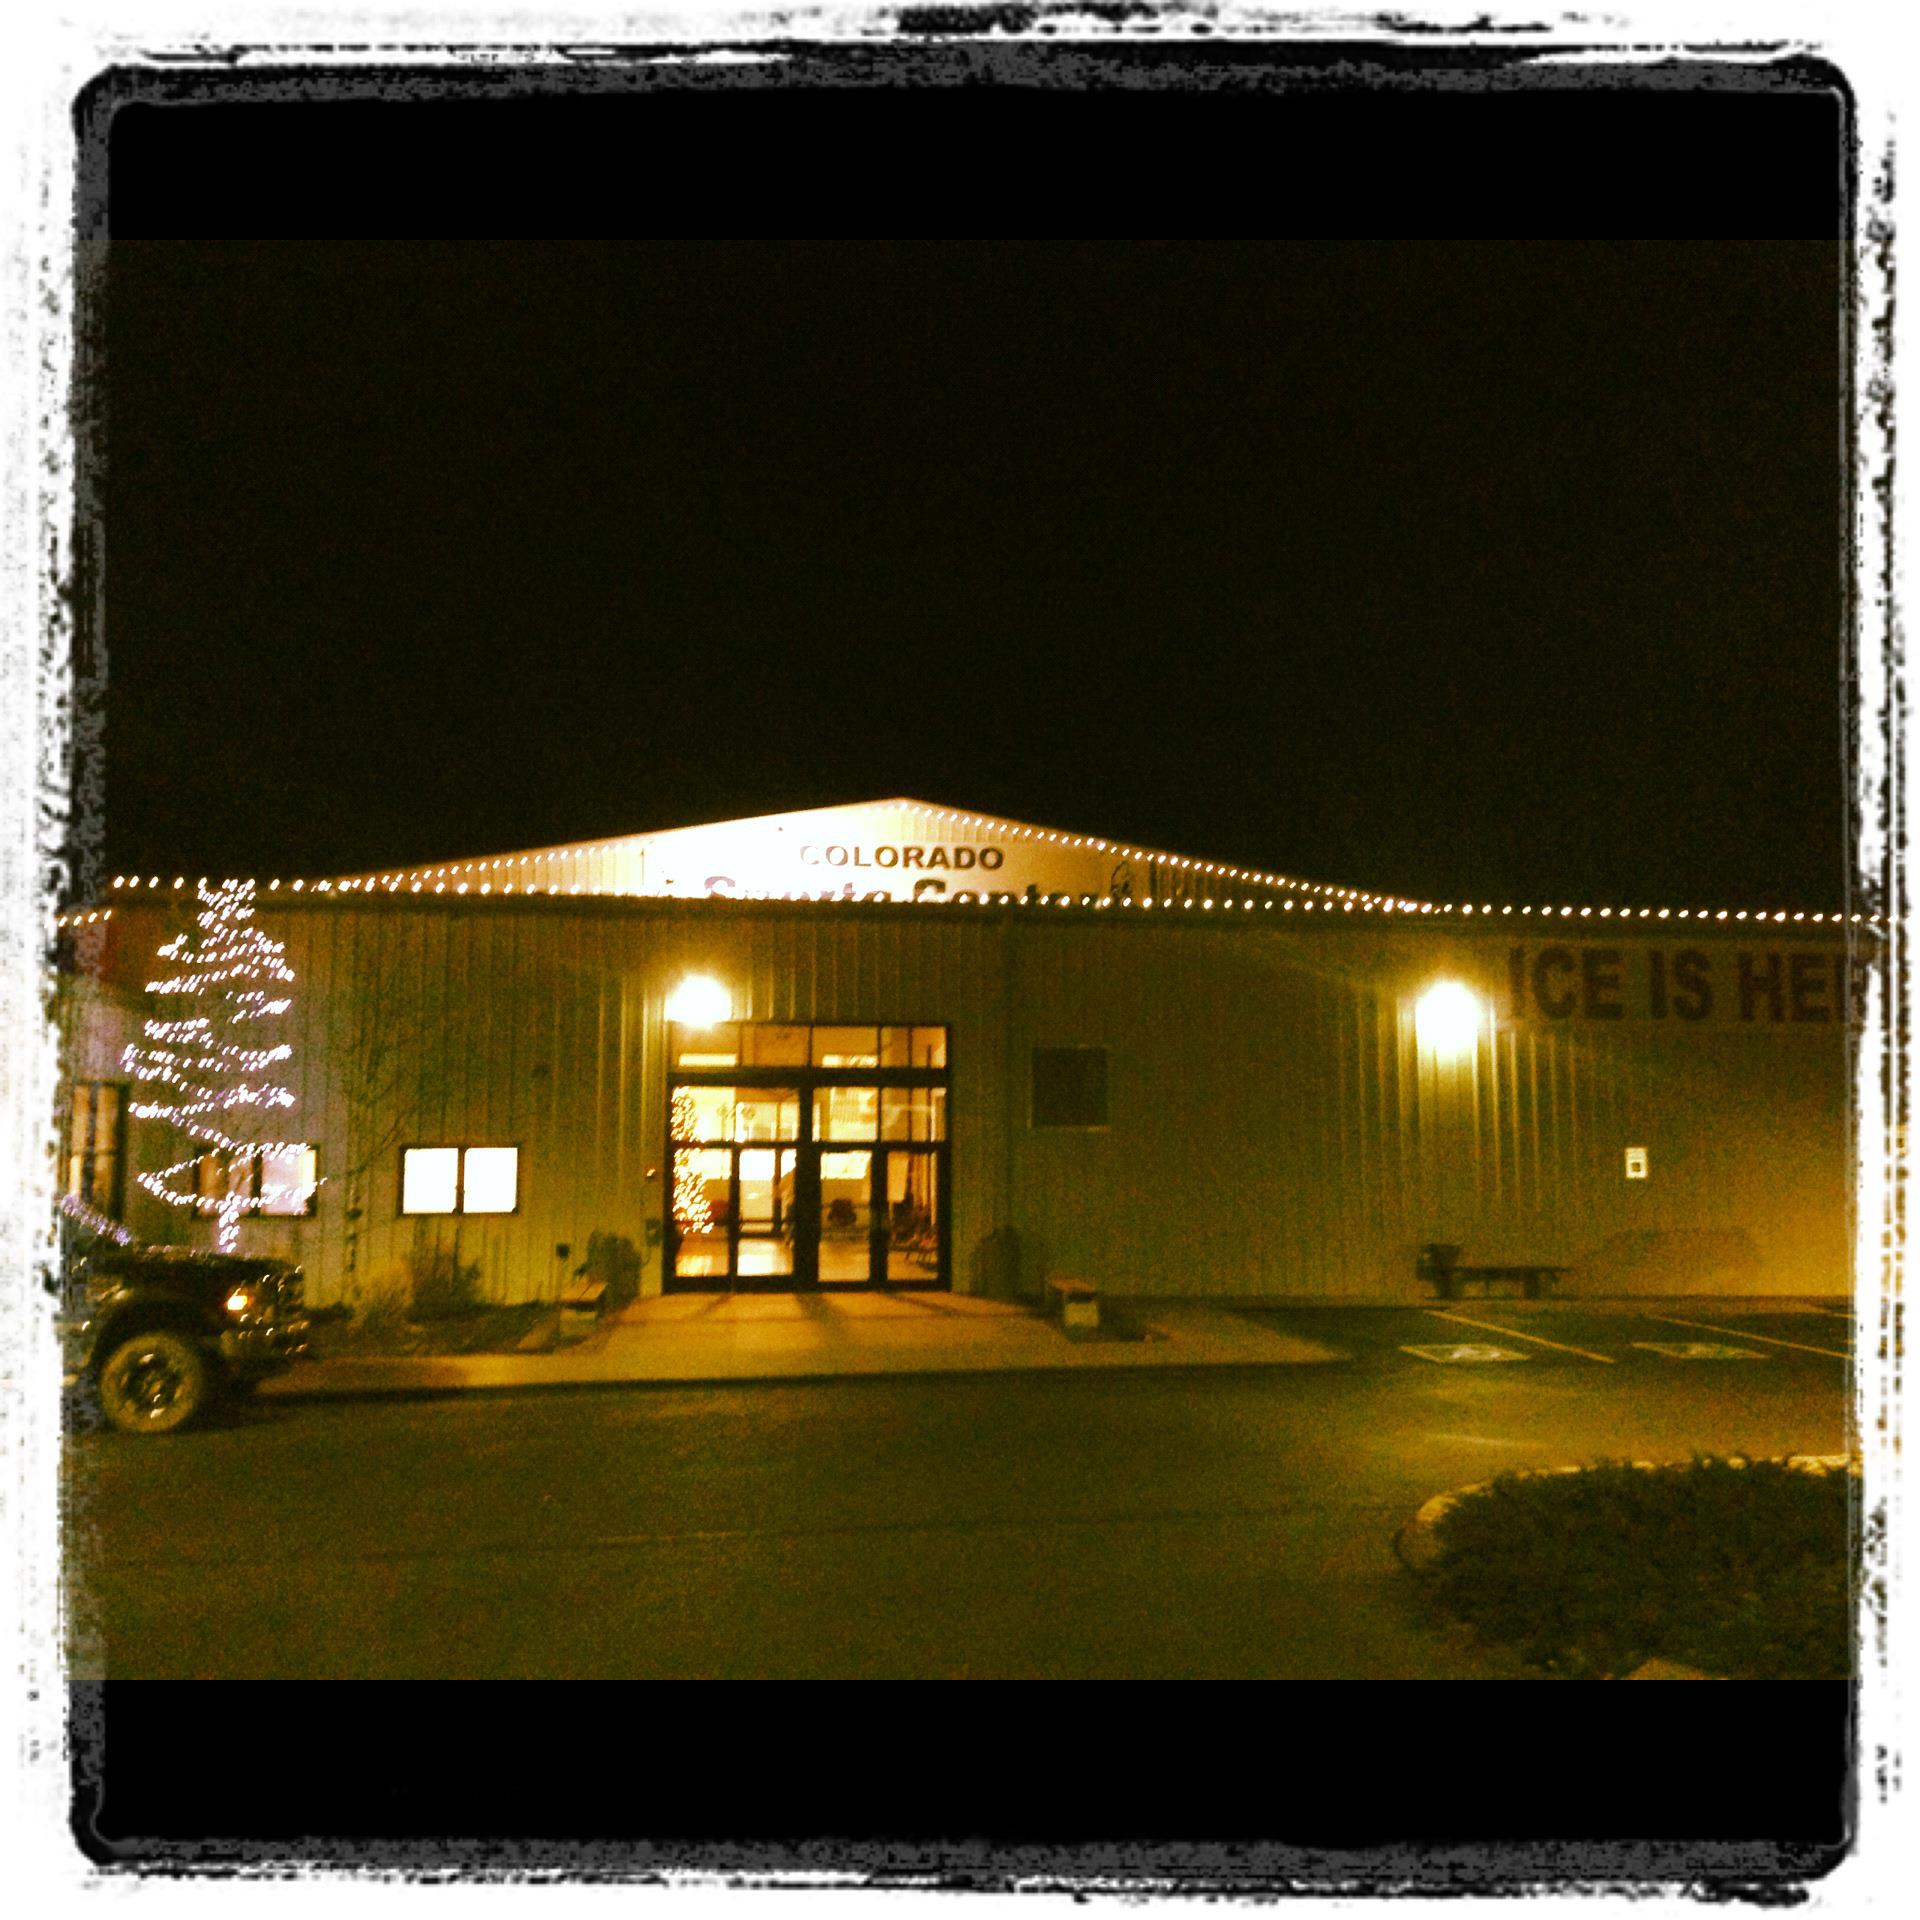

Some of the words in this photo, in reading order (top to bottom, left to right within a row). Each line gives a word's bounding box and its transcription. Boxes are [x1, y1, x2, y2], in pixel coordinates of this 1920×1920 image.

[801, 845, 1003, 870] COLORADO
[1508, 947, 1624, 1021] ICE
[1647, 949, 1712, 1022] IS
